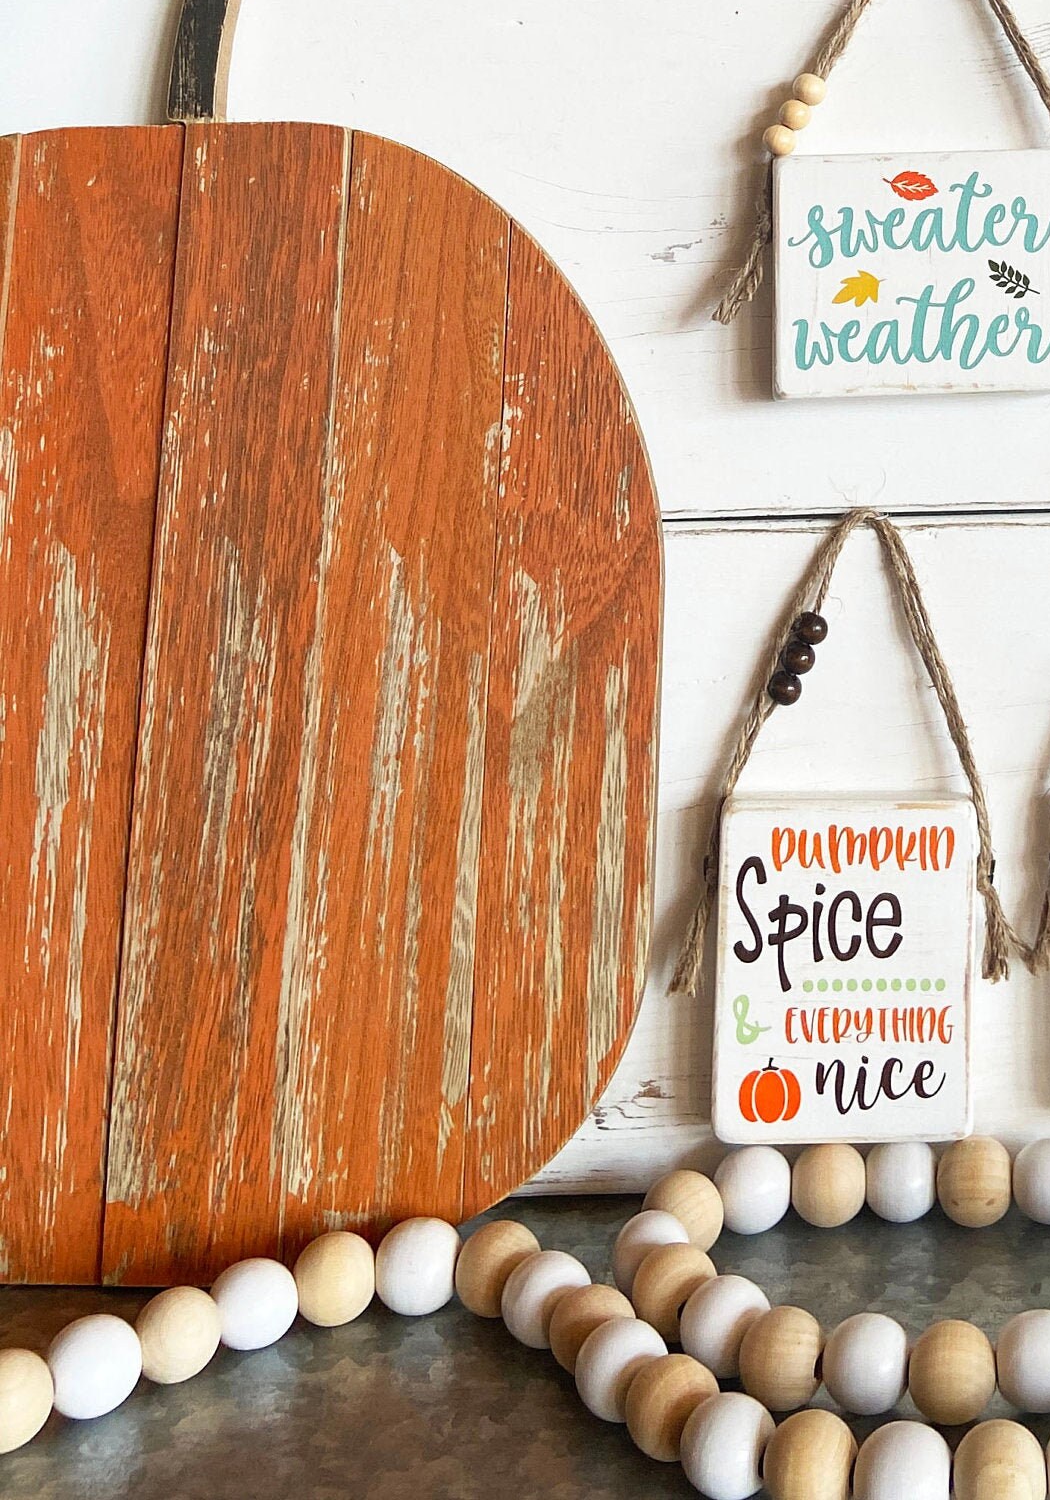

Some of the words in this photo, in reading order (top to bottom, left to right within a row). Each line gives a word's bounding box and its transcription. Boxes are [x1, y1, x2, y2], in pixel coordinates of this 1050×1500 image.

[733, 856, 903, 993] Spice
[733, 994, 771, 1044] &
[816, 1055, 946, 1115] nice
